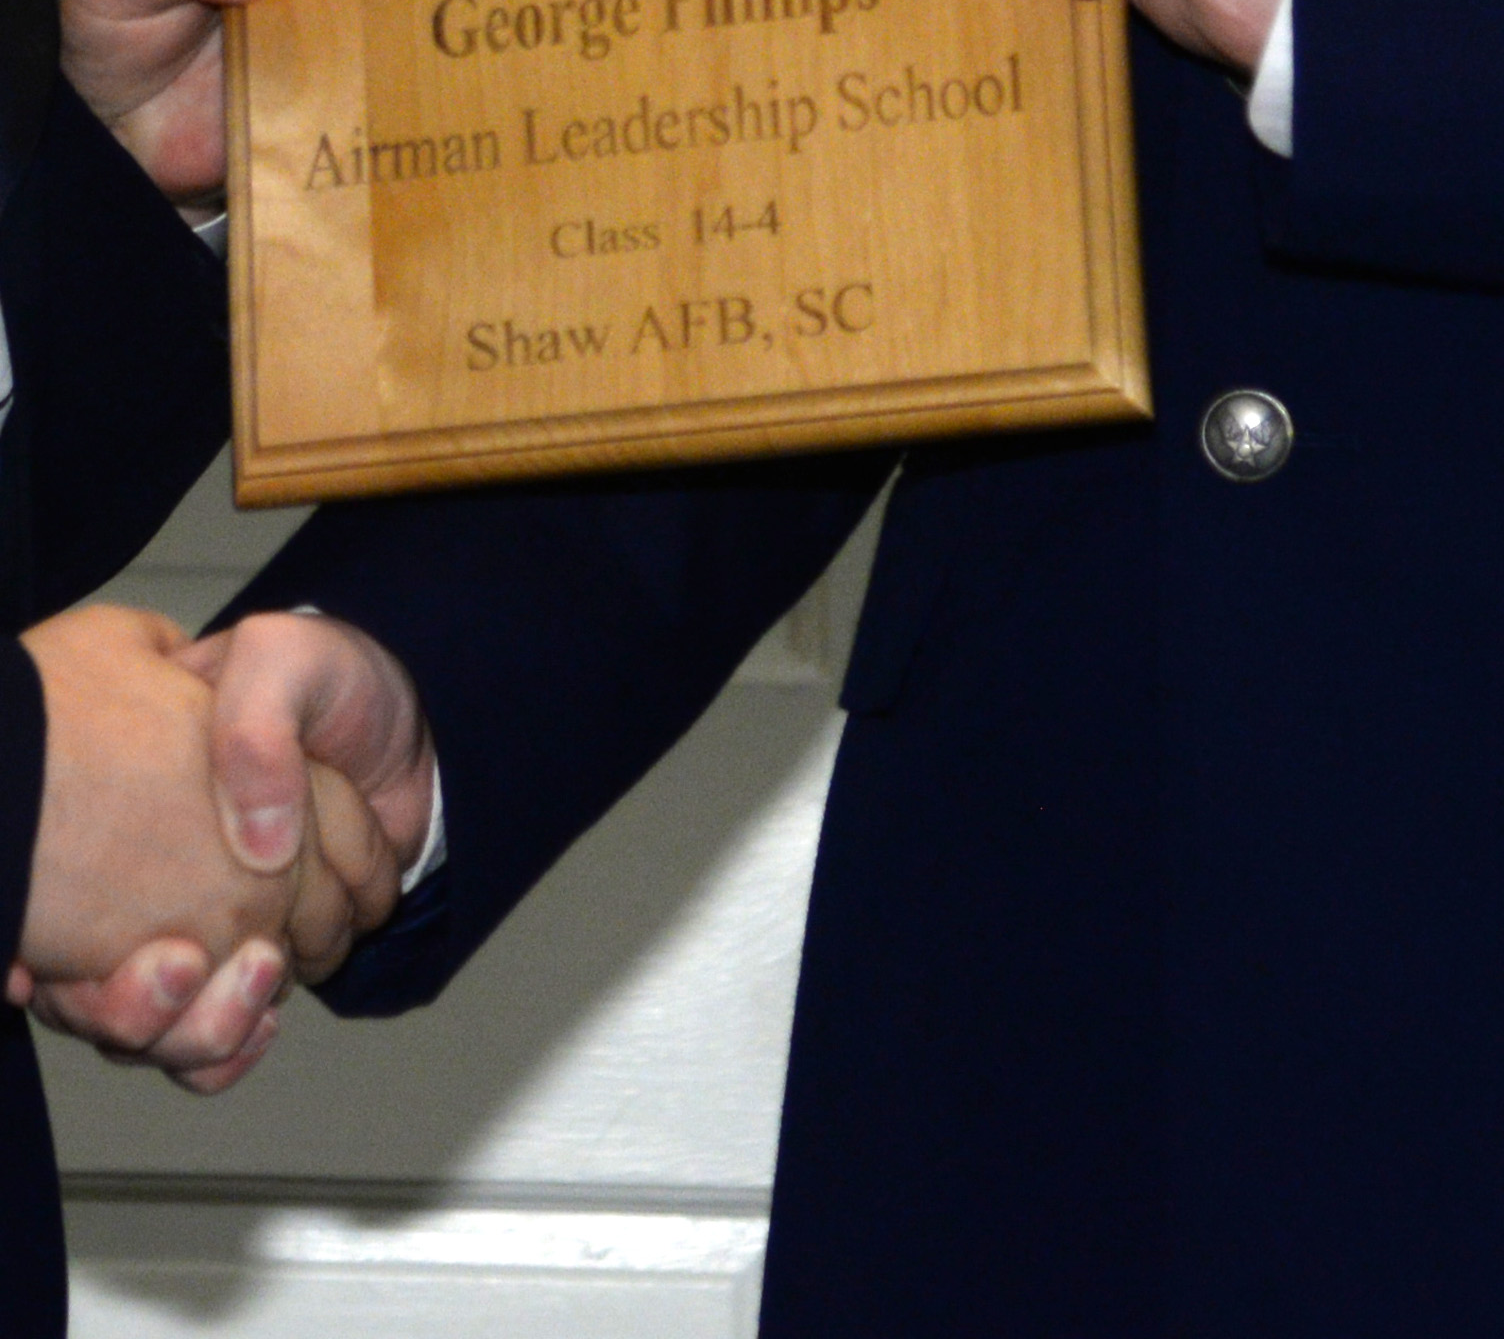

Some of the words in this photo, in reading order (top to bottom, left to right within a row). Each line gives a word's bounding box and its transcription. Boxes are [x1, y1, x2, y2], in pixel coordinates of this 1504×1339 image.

[302, 124, 502, 194] Airman
[523, 78, 820, 167] Leadership
[836, 53, 1025, 133] School
[550, 219, 662, 261] Class
[691, 199, 782, 245] 14-4
[465, 320, 608, 372] Shaw
[629, 294, 775, 356] AFB,
[794, 282, 874, 340] SC
